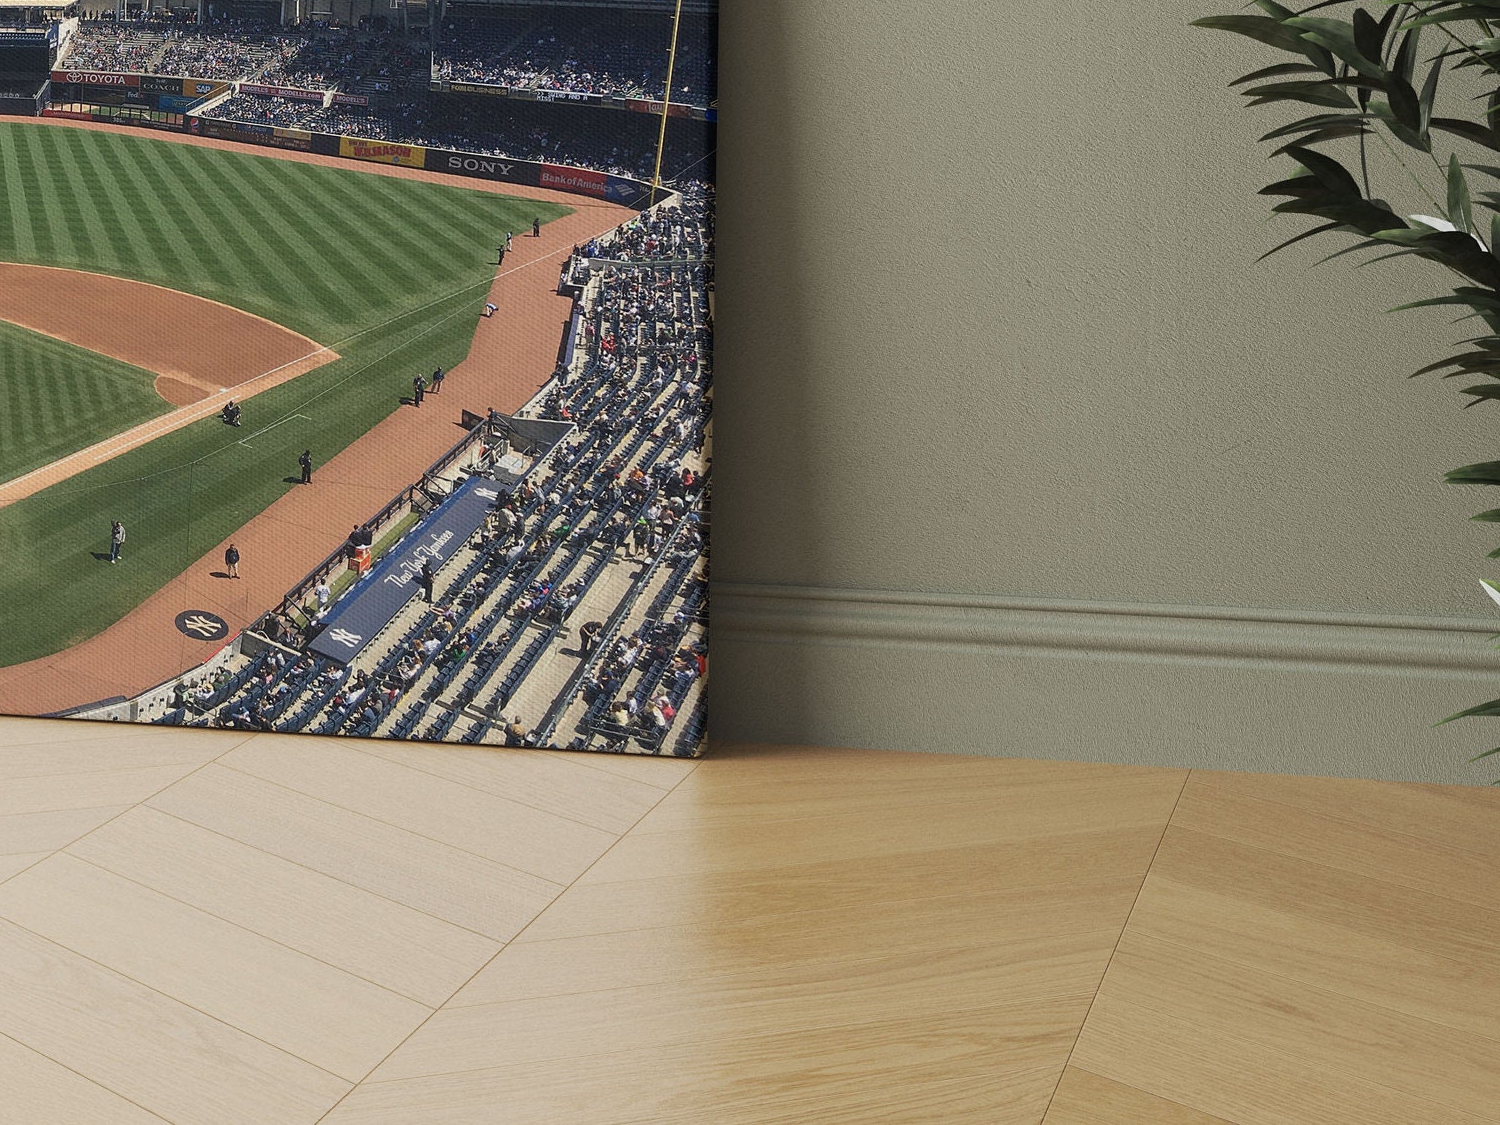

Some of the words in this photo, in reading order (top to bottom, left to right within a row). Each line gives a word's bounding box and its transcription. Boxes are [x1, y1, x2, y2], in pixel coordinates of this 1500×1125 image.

[83, 73, 125, 85] TOYOTA
[143, 83, 179, 92] COACH
[196, 85, 211, 93] SAP
[448, 156, 514, 176] SONY
[542, 173, 566, 184] Bank
[567, 176, 577, 185] of
[577, 178, 612, 193] America
[384, 570, 414, 588] New
[416, 530, 454, 561] Yankees
